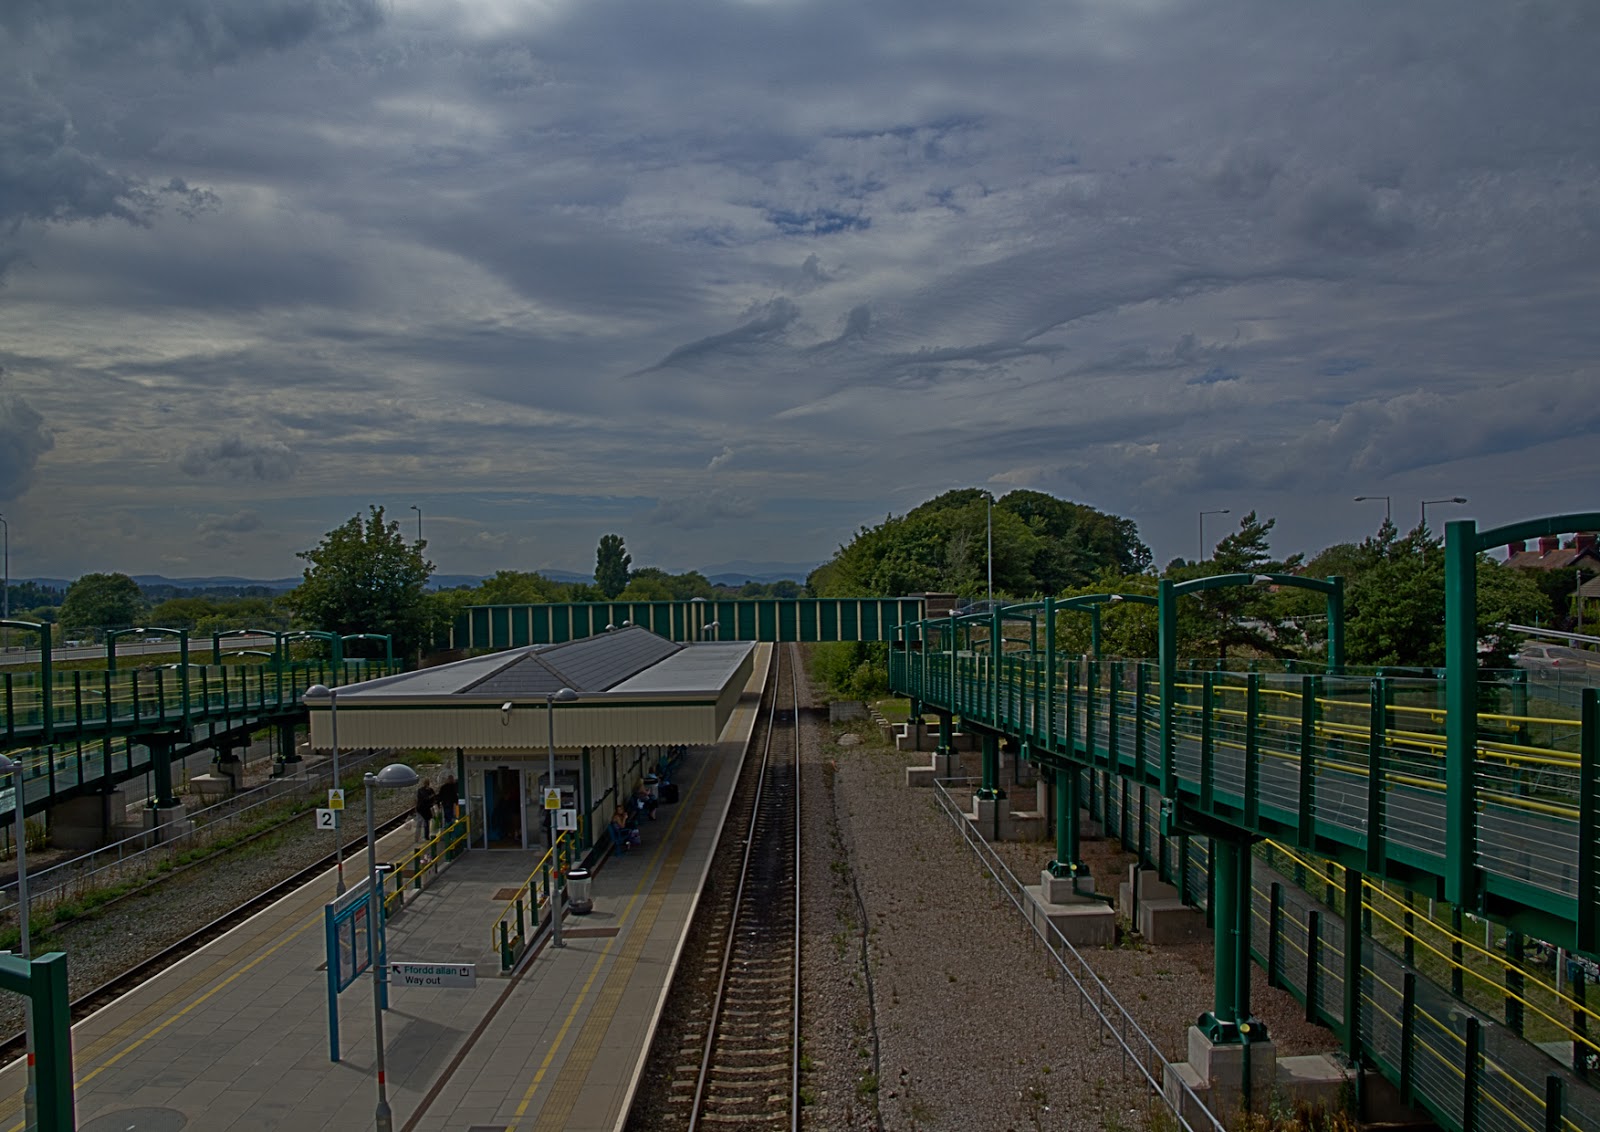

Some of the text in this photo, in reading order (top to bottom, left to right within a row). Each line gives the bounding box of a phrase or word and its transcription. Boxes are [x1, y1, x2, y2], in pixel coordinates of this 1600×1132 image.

[322, 812, 332, 826] 2
[562, 812, 569, 826] 1
[404, 966, 457, 975] Ffordd allan
[405, 976, 441, 985] Way out
